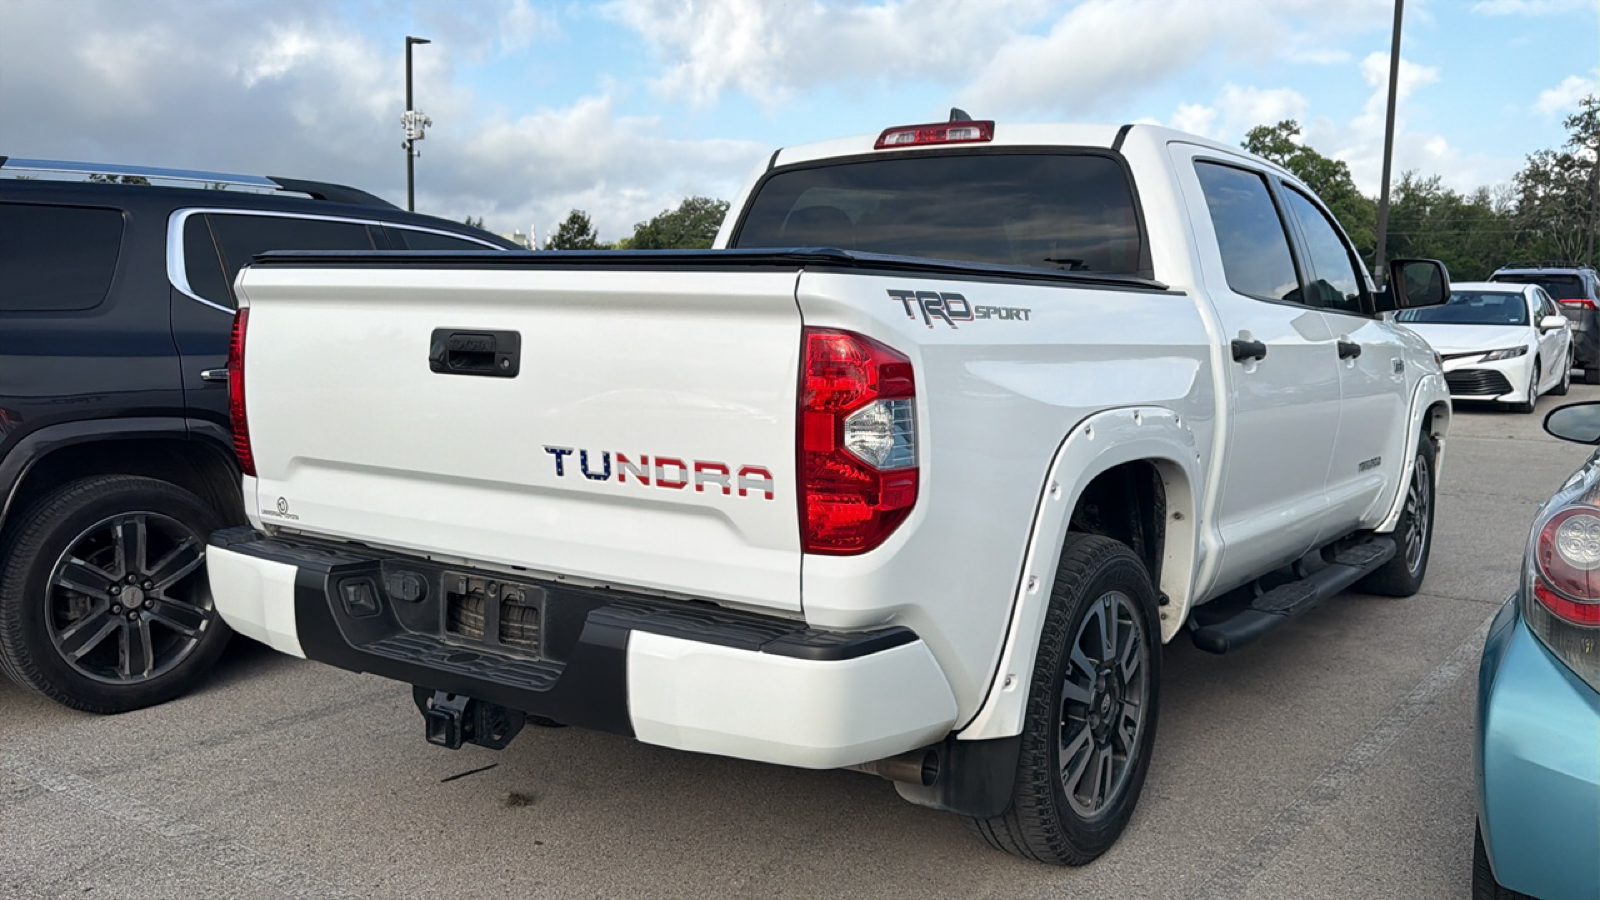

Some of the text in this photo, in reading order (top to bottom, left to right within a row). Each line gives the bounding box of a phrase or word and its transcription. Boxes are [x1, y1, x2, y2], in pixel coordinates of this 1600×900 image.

[886, 289, 1032, 329] TRD SPORT
[542, 444, 774, 500] TUNDRA
